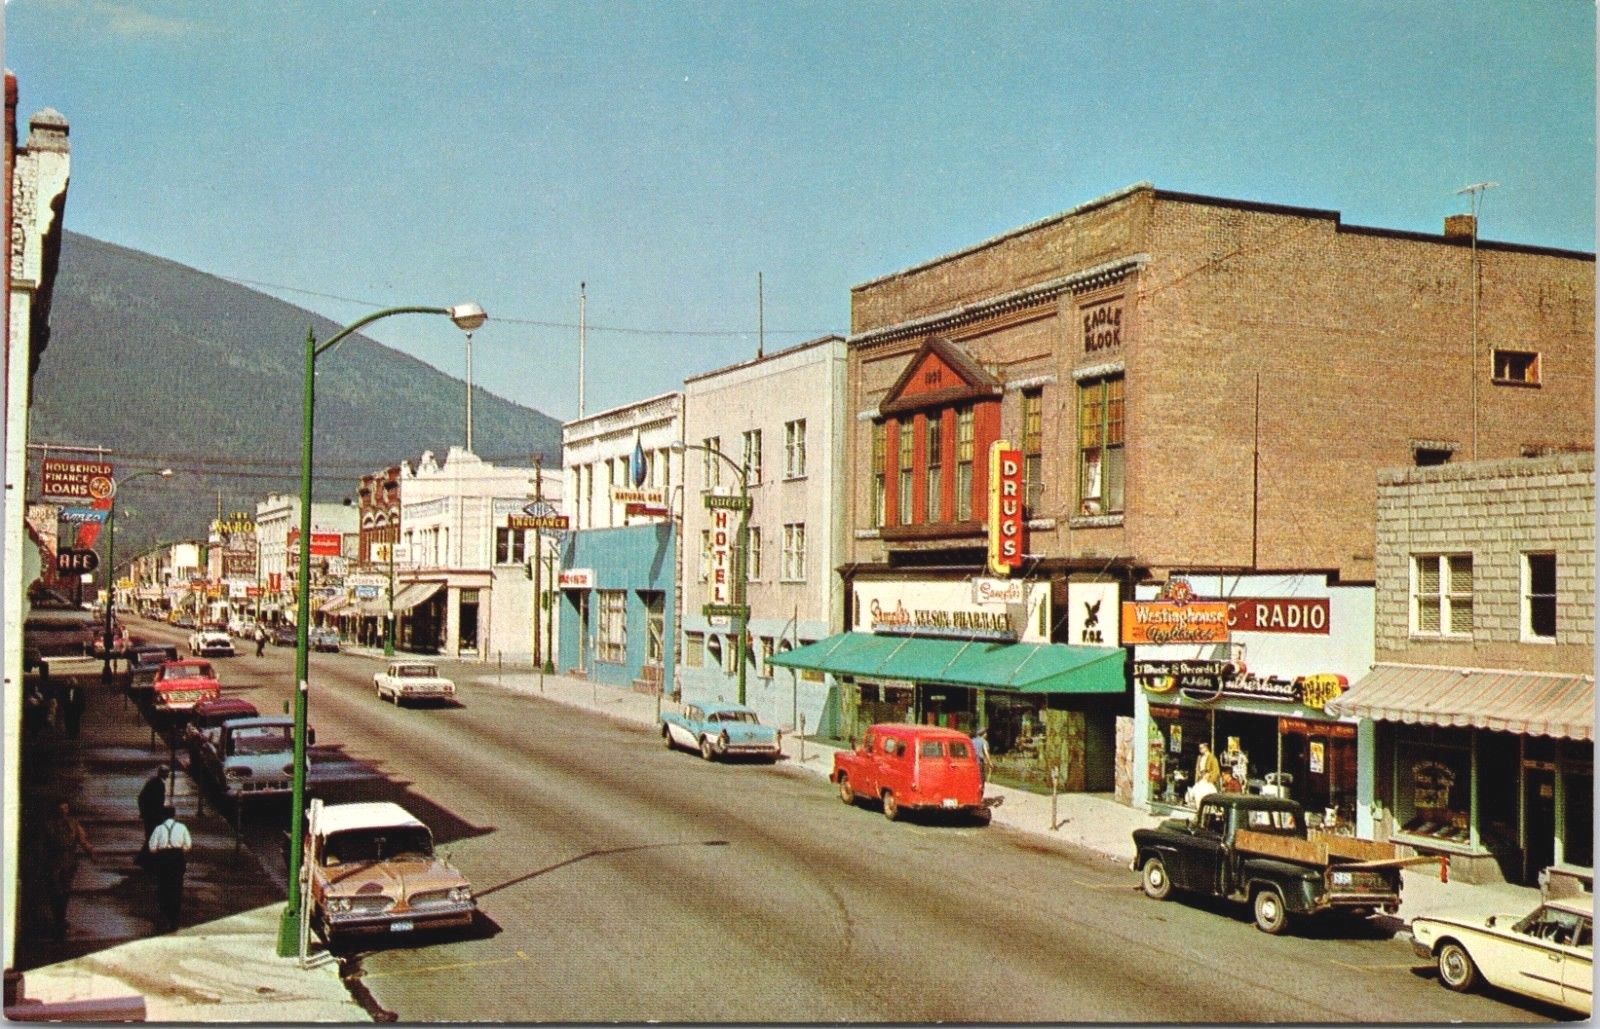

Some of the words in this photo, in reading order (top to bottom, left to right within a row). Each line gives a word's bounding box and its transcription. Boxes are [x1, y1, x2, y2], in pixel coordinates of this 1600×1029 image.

[45, 462, 111, 474] HOUSEHOLD
[45, 474, 89, 483] FINANCE
[44, 483, 89, 495] LOANS
[615, 492, 645, 502] NATURAL
[648, 493, 662, 503] GAS
[1002, 460, 1018, 557] DRUGS
[512, 517, 567, 528] INSURANCE
[59, 554, 92, 569] AFE
[714, 511, 727, 602] HOTEL
[952, 610, 1012, 632] PHARMACY
[1135, 605, 1225, 629] Westinghouse
[1255, 603, 1326, 629] RADIO
